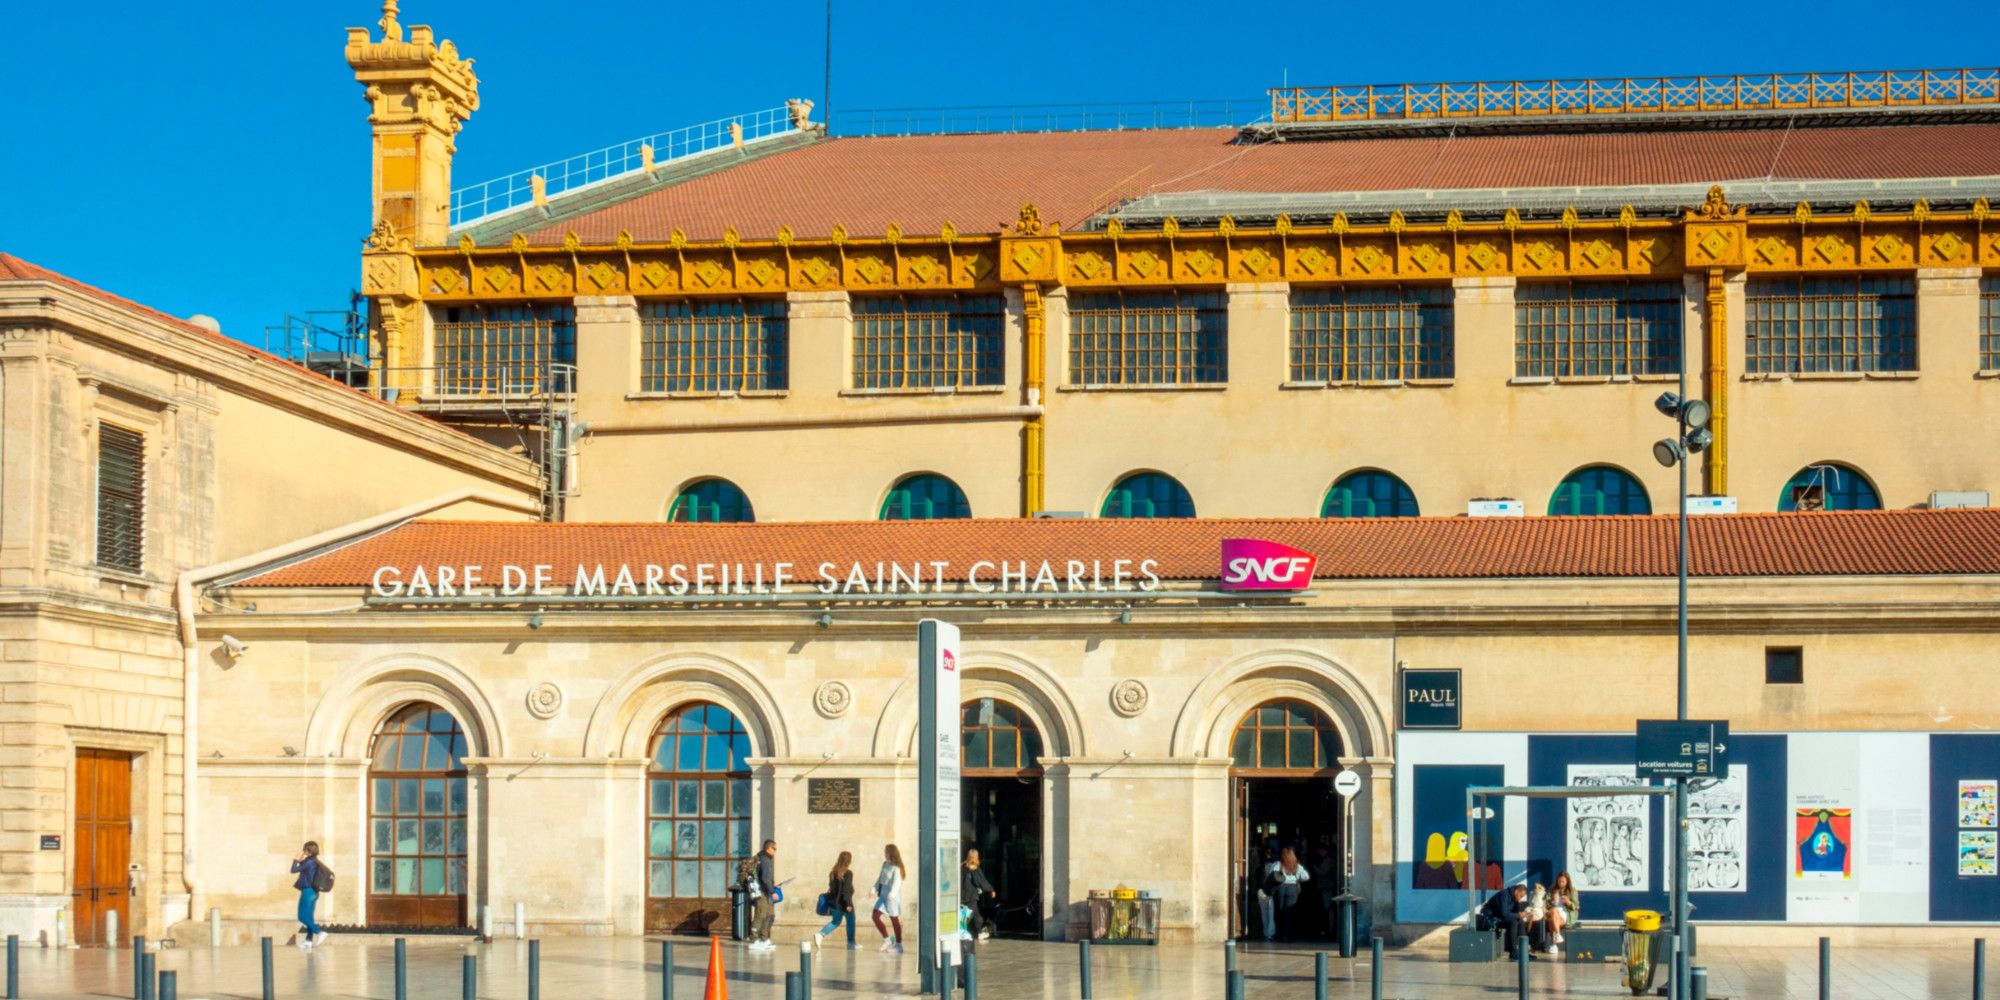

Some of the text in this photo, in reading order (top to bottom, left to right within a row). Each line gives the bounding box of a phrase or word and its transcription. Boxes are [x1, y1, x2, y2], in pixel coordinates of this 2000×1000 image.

[372, 559, 1160, 597] GARE DE MARSEILLE SAINT CHARLES
[1225, 557, 1310, 582] SNCF
[1408, 689, 1456, 702] PAUL
[1638, 760, 1693, 768] Location voitures
